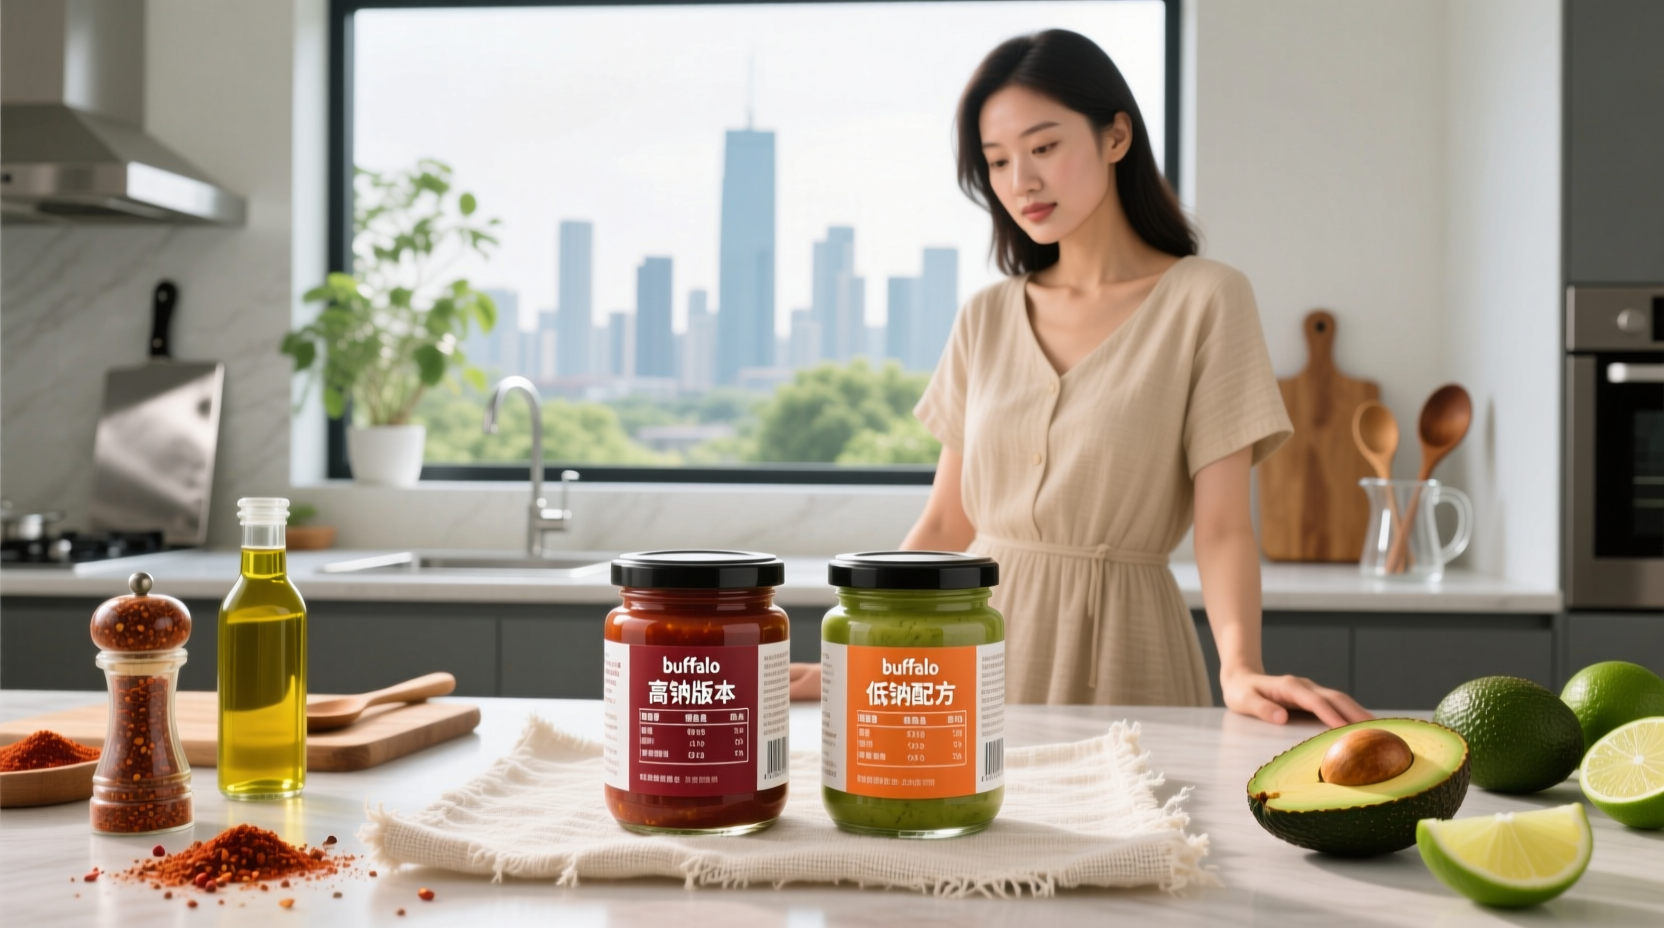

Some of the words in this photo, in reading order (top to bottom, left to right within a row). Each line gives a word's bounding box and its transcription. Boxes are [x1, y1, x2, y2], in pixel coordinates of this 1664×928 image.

[662, 656, 721, 674] buffalo
[882, 658, 939, 676] buffalo
[648, 679, 736, 705] 高钠版本
[866, 681, 956, 707] 低钠配方
